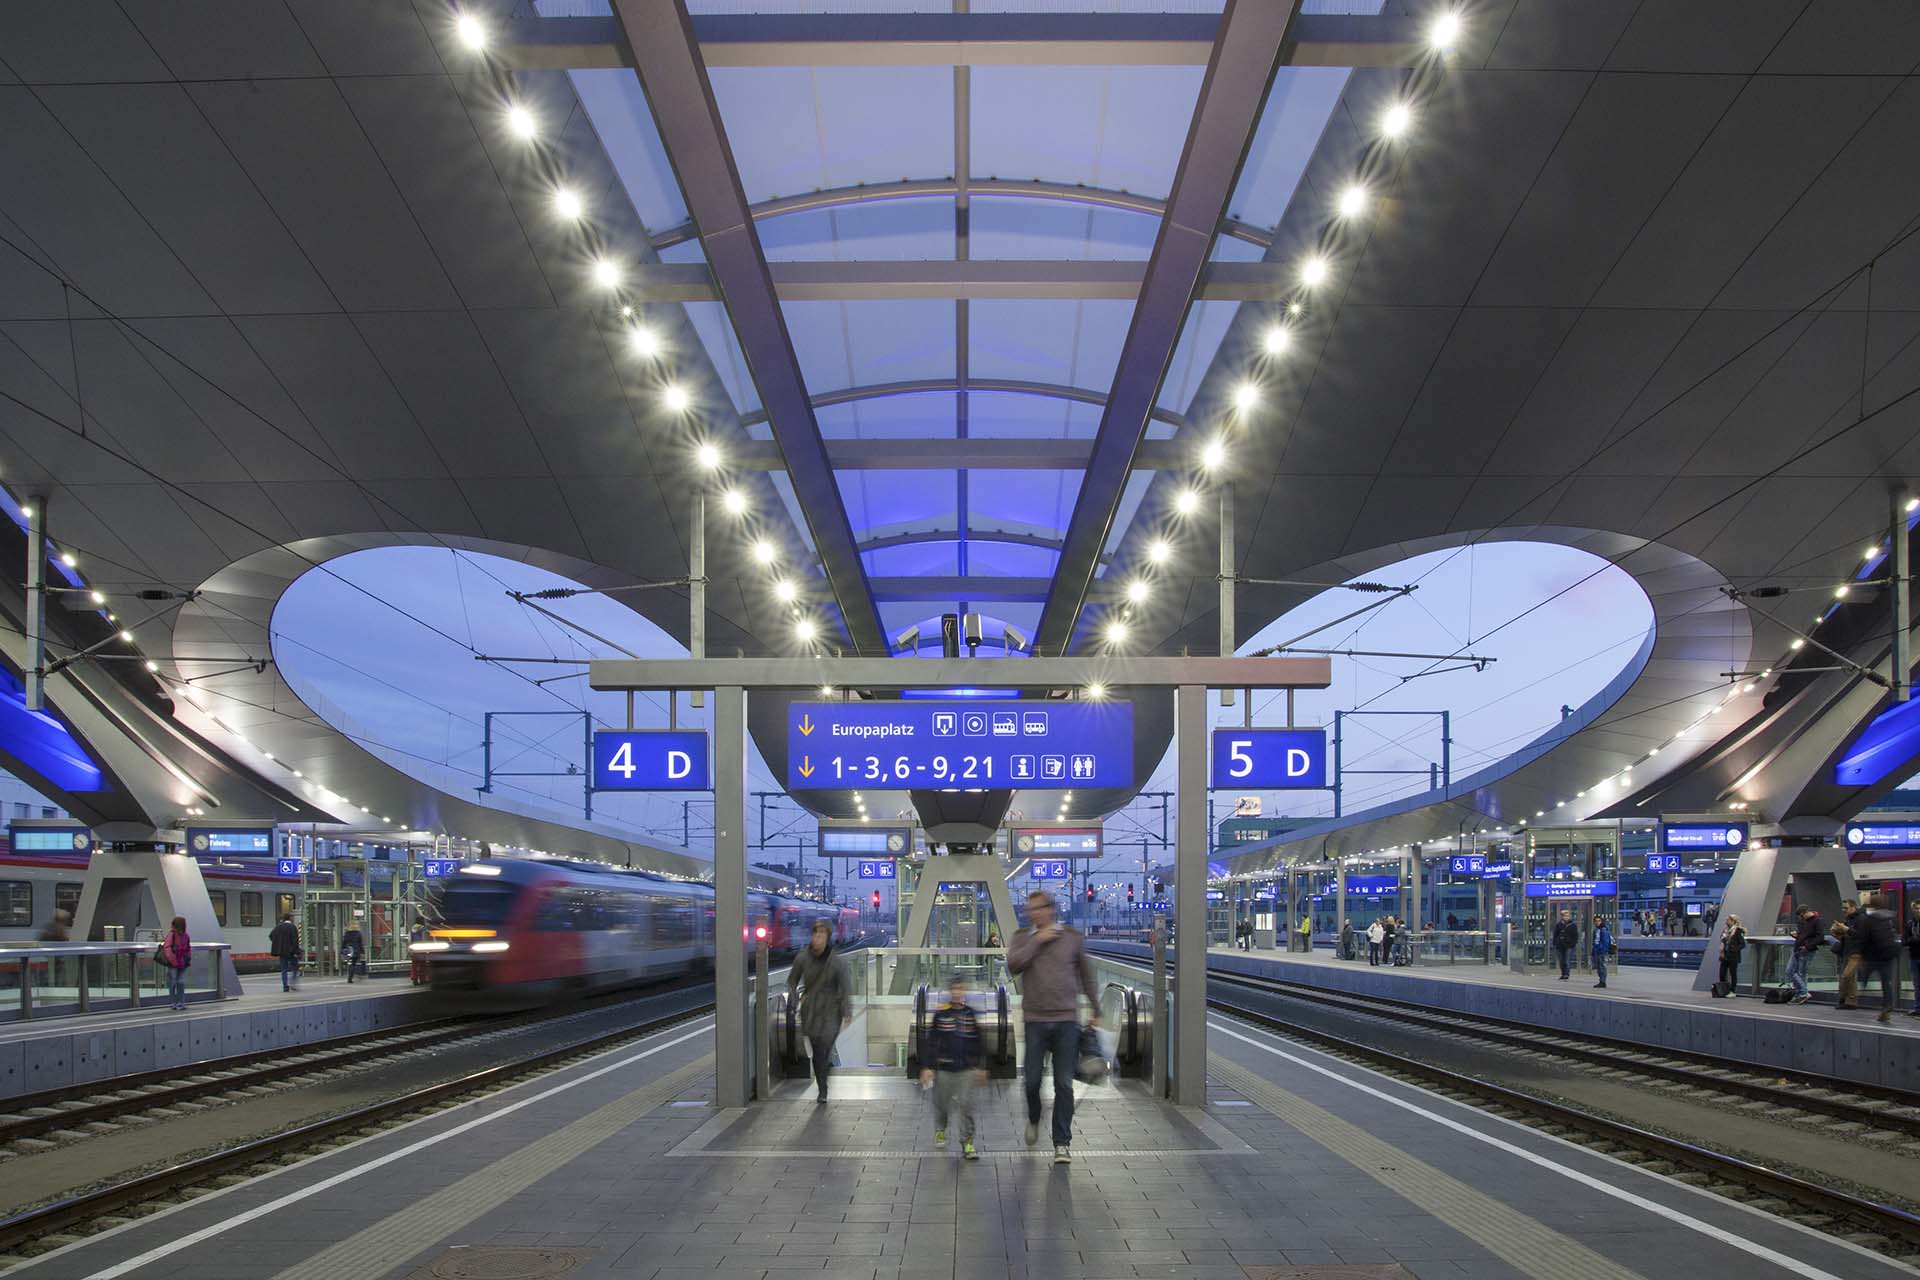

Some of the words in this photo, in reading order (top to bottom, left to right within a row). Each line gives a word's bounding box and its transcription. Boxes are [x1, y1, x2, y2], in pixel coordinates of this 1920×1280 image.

[832, 722, 914, 740] Europaplatz
[607, 742, 637, 779] 4
[667, 750, 692, 779] D
[1229, 740, 1254, 778] 5
[1287, 748, 1311, 777] D
